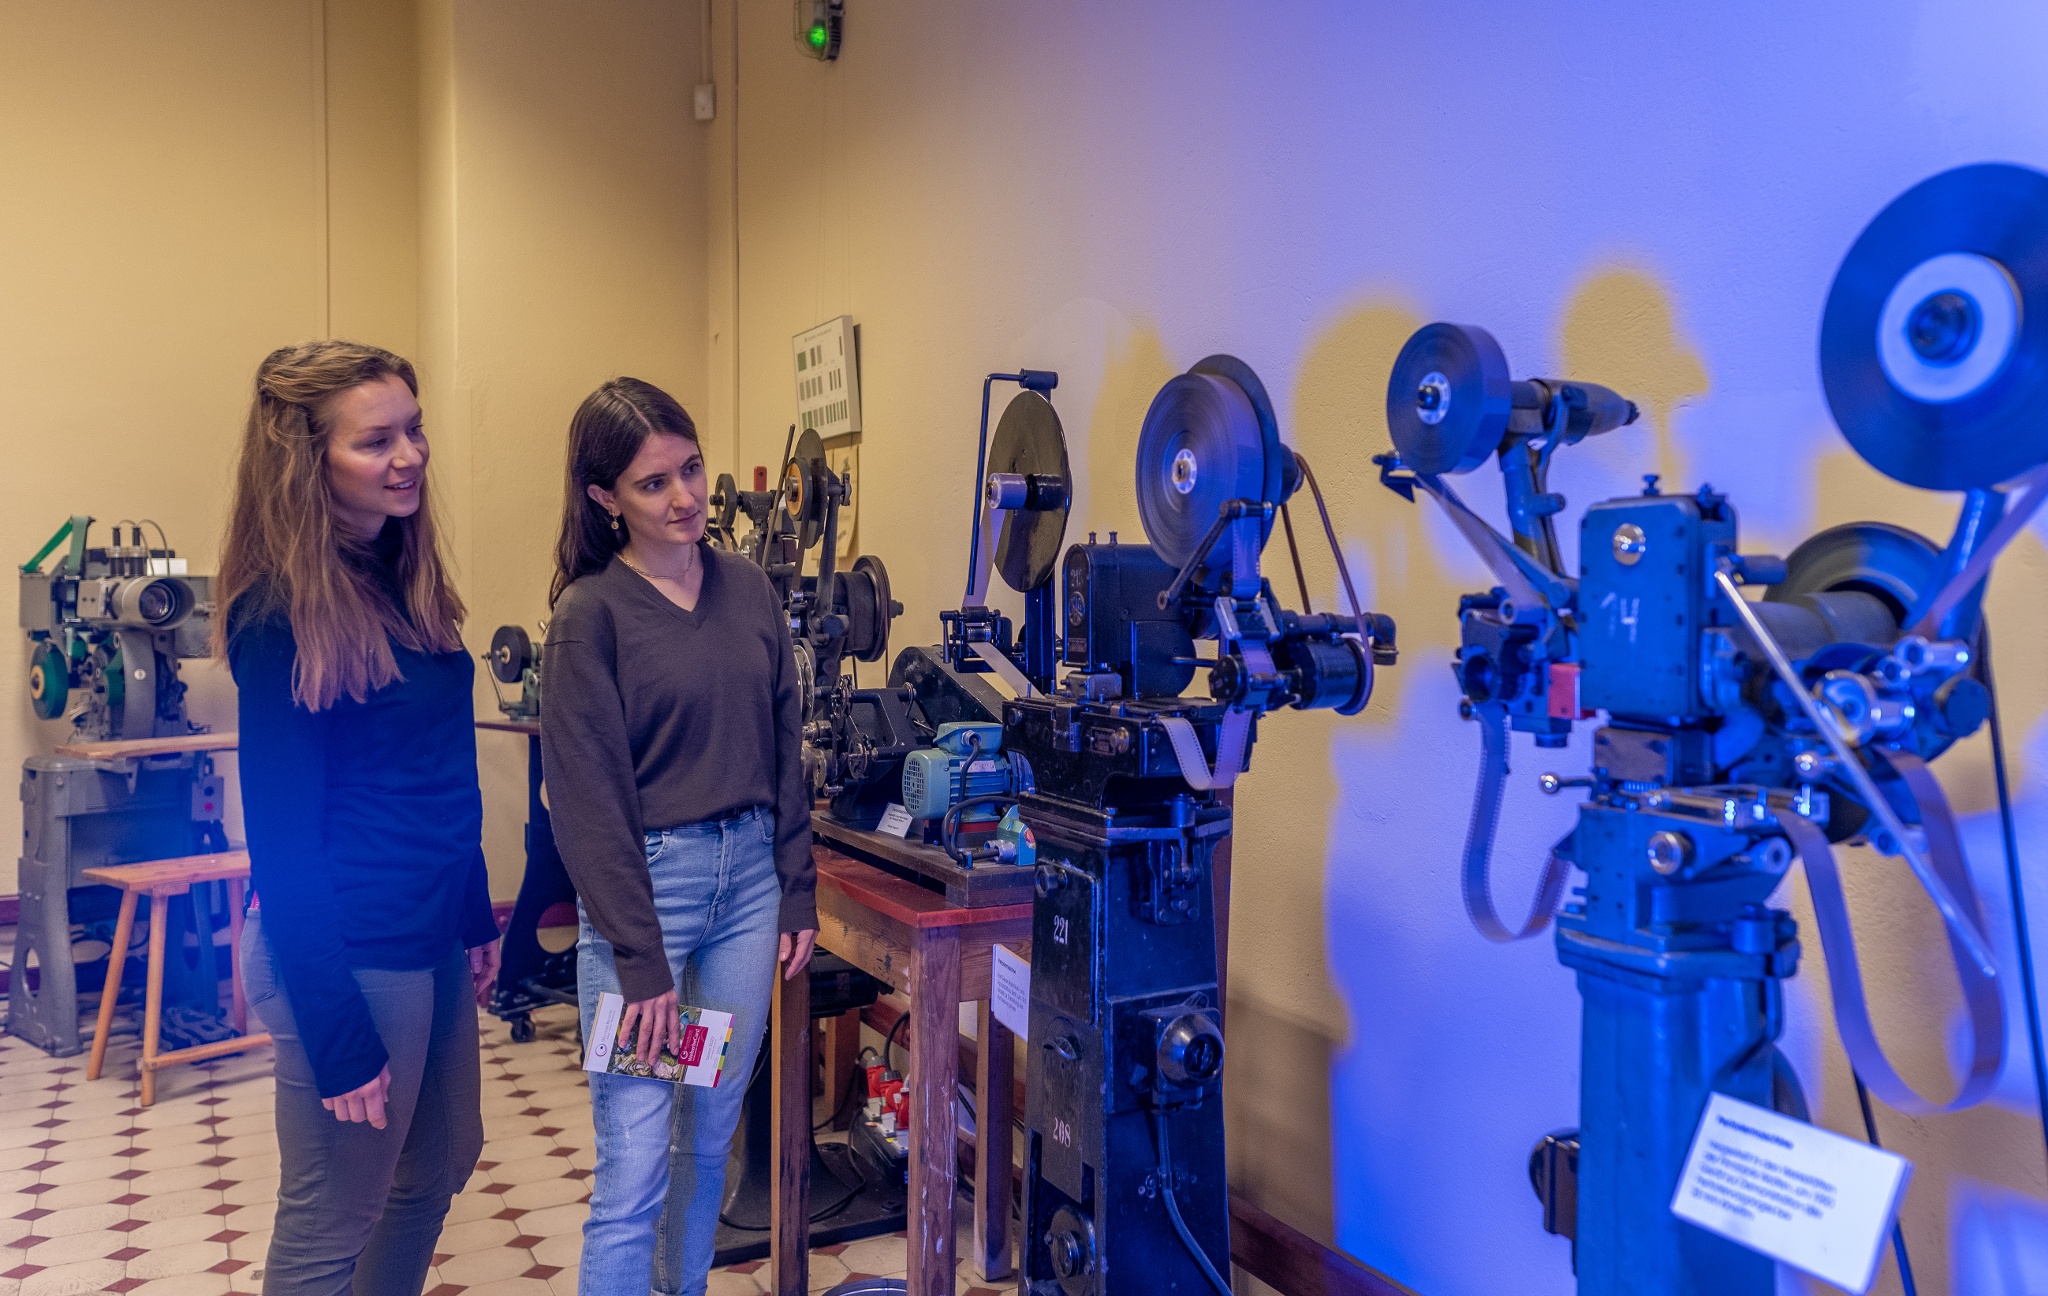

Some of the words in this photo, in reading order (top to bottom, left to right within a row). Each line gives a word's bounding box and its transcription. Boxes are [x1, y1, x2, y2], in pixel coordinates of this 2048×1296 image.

[1600, 592, 1640, 643] 14
[1053, 914, 1069, 945] 221
[1052, 1116, 1071, 1148] 208
